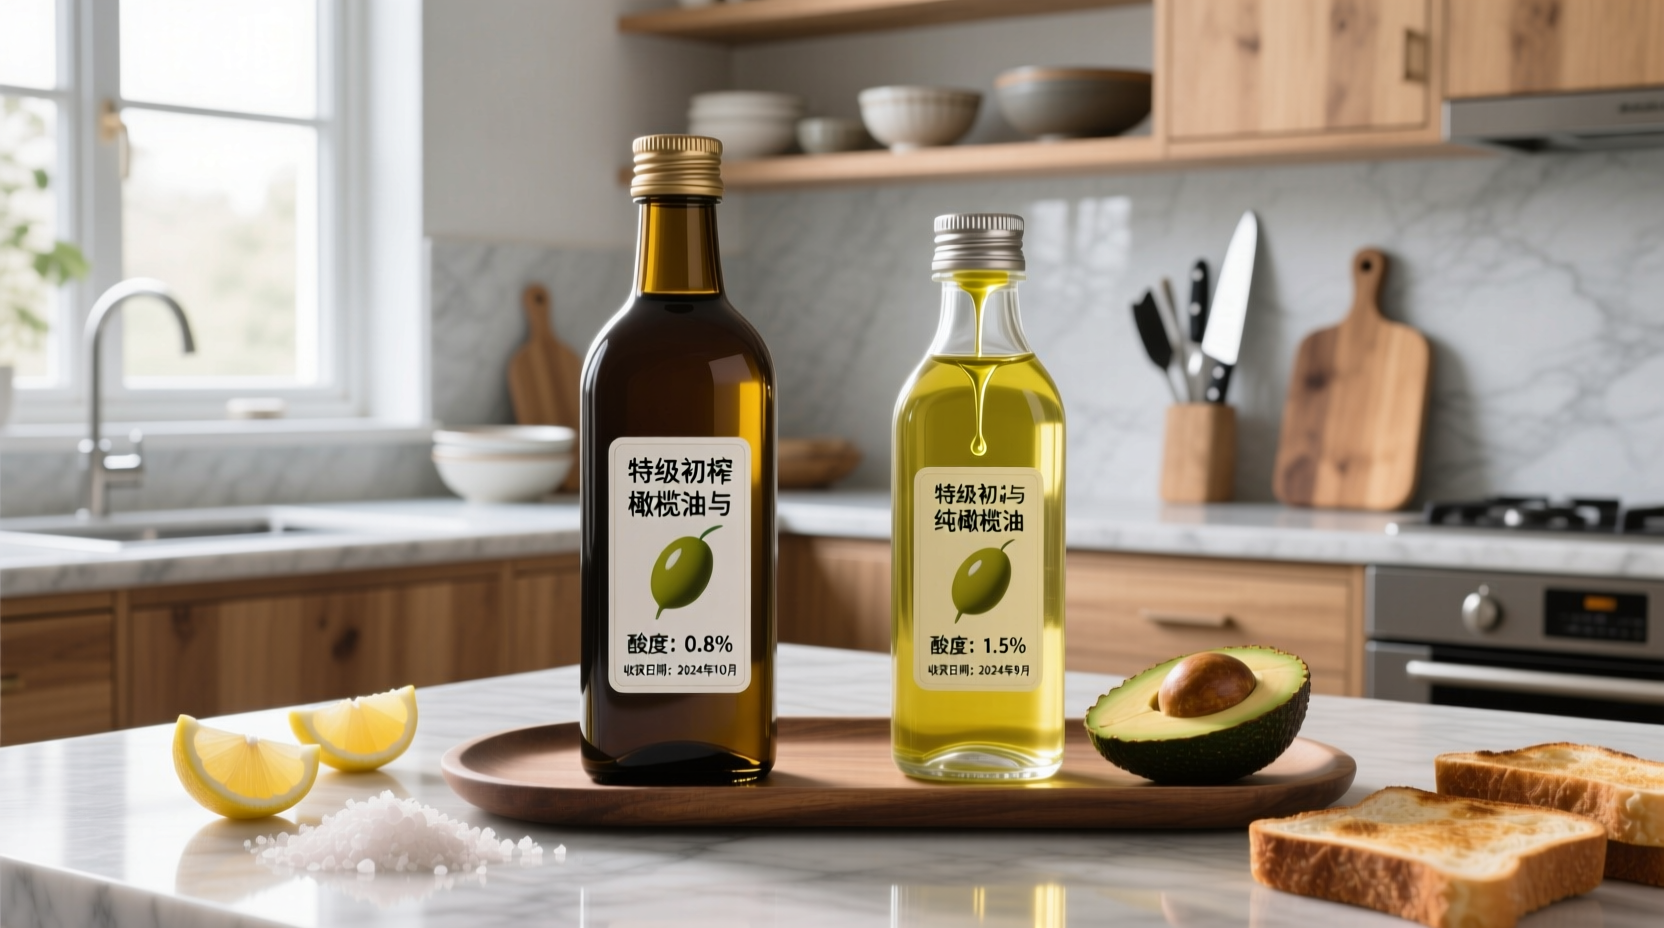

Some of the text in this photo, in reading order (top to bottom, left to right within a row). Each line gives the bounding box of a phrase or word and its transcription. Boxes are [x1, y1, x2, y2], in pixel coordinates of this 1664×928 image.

[628, 457, 733, 485] 特级初榨
[628, 490, 731, 517] 橄榄油与
[934, 508, 1024, 532] 纯橄榄油
[684, 635, 733, 653] 0.8%
[983, 637, 1027, 653] 1.5%
